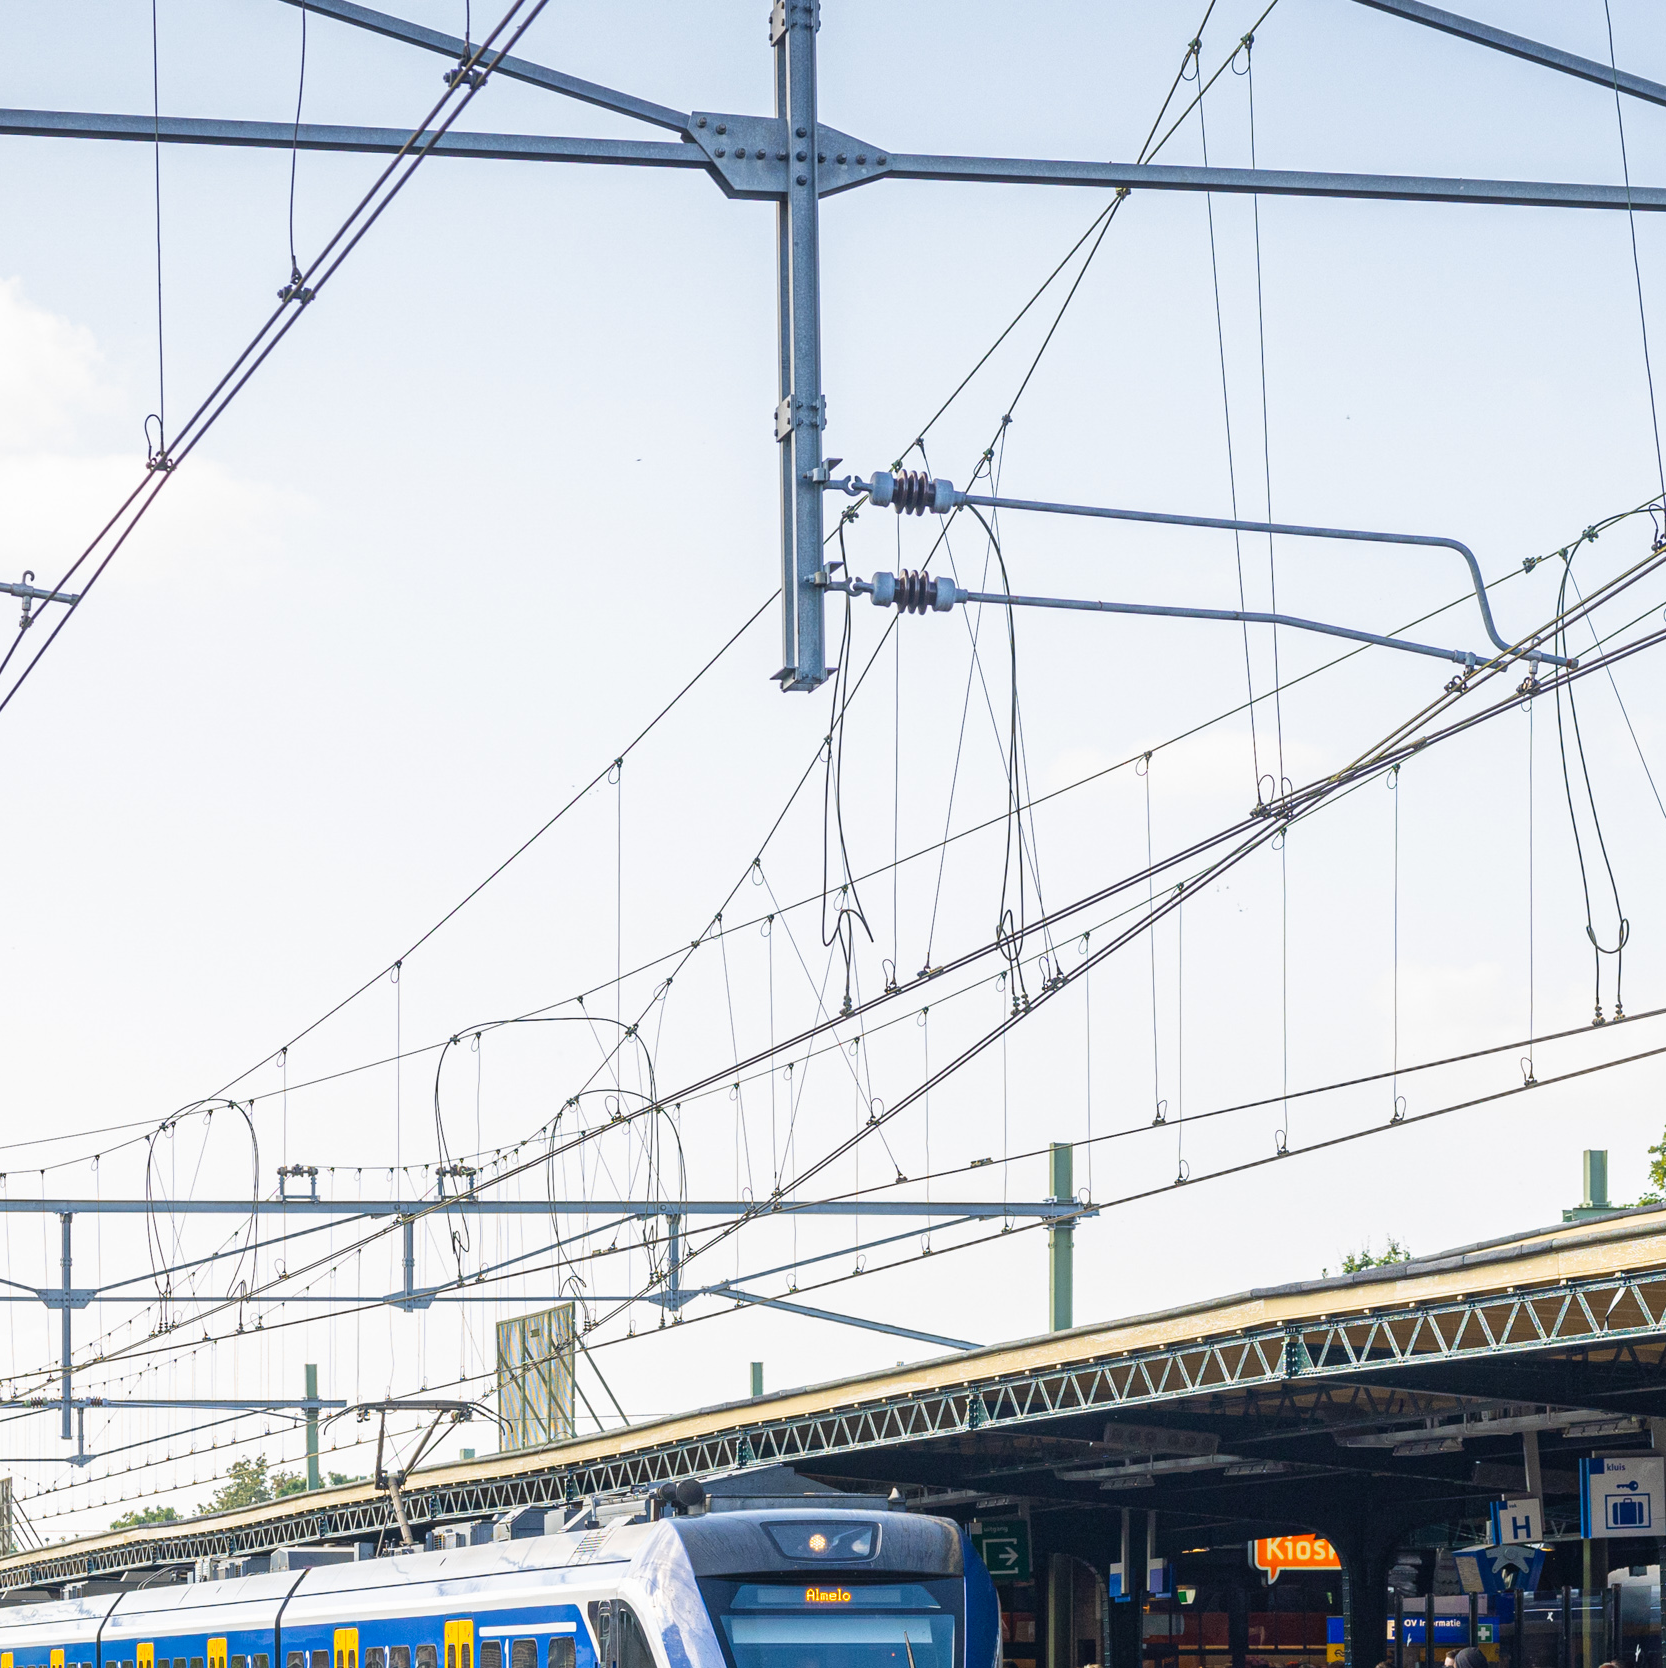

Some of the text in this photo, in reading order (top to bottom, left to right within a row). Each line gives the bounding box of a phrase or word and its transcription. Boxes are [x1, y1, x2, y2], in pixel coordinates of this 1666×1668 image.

[1607, 1463, 1626, 1471] kluis
[1512, 1515, 1531, 1539] H
[806, 1588, 851, 1602] Almelo
[1403, 1618, 1417, 1627] OV
